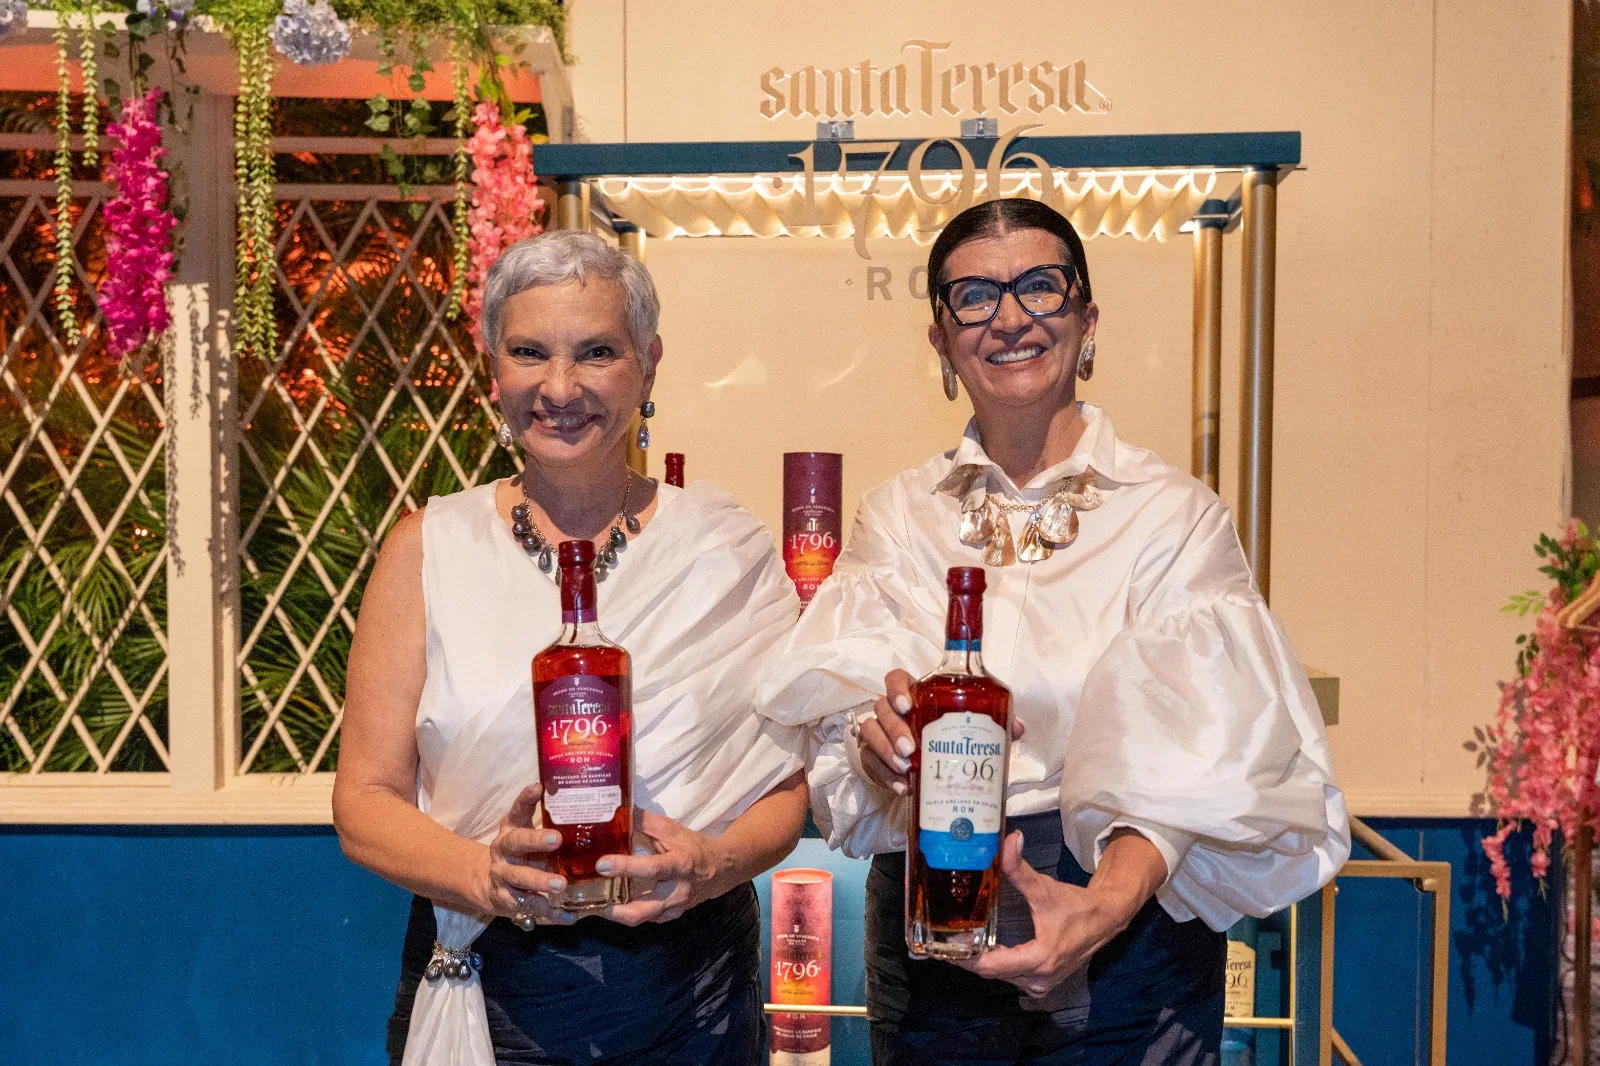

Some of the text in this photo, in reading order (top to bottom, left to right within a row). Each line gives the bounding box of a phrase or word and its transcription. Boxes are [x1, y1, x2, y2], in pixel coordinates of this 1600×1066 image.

[787, 124, 1050, 260] 1796
[867, 266, 929, 300] RO
[792, 531, 834, 555] 1796
[551, 714, 608, 745] 1796
[928, 736, 1001, 756] santaTeresa
[952, 805, 975, 813] RON
[776, 960, 819, 983] 1796
[1226, 958, 1252, 970] Teresa
[1226, 971, 1248, 989] 96
